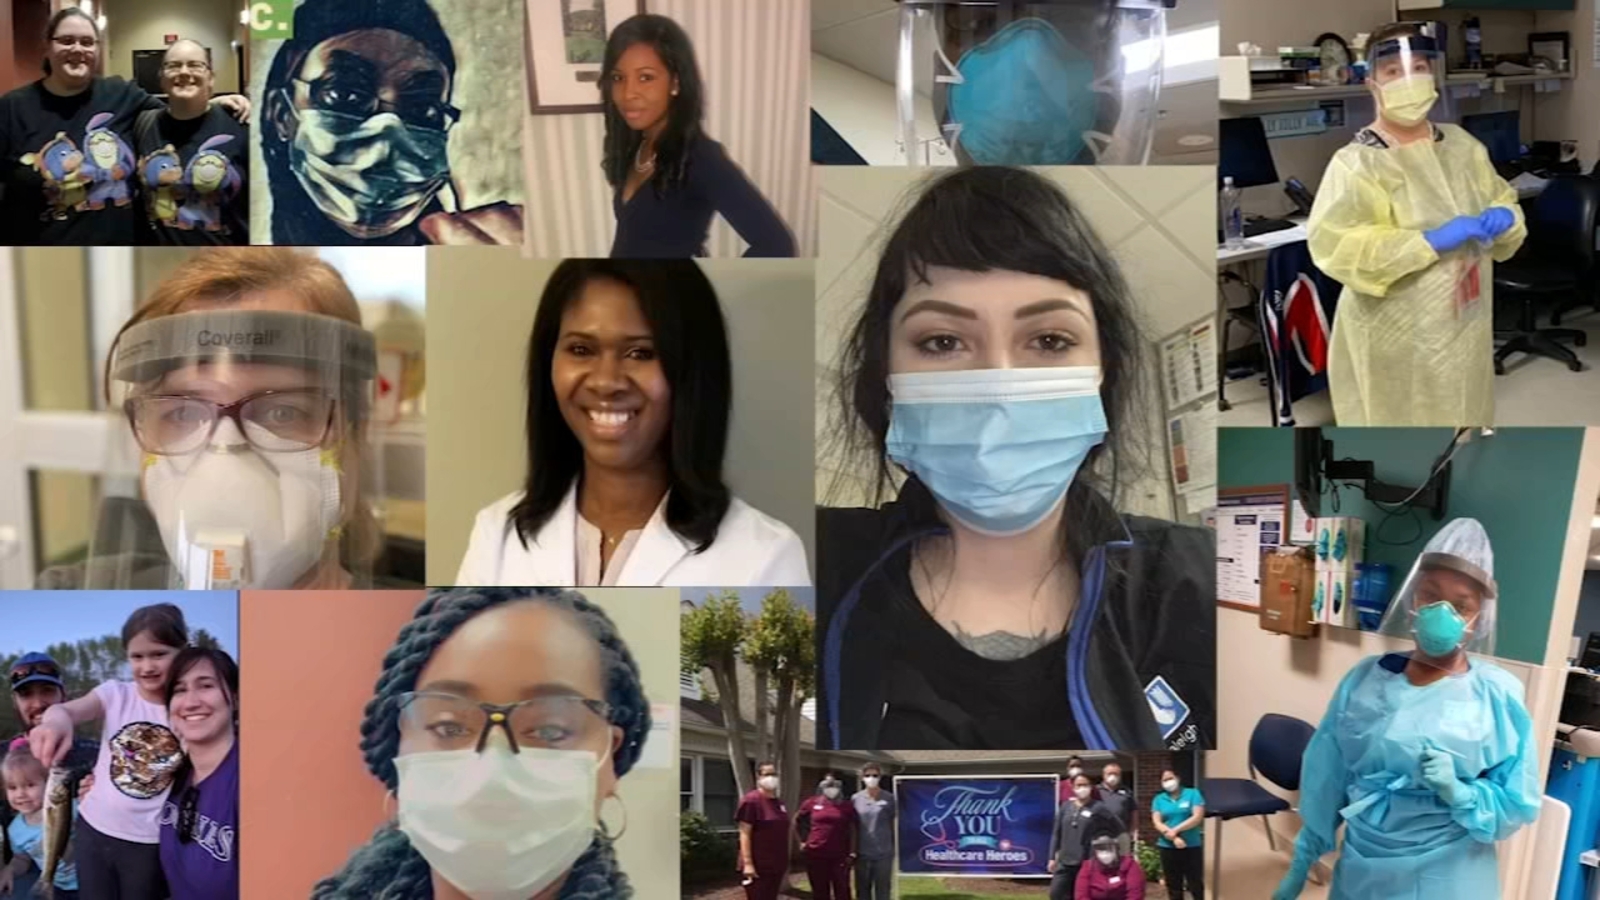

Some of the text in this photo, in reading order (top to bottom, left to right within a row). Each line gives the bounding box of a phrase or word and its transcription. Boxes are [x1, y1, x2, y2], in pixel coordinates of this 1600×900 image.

[934, 785, 1018, 822] Thank
[954, 815, 1001, 835] YOU
[925, 849, 1028, 862] Healthcare Heroes
